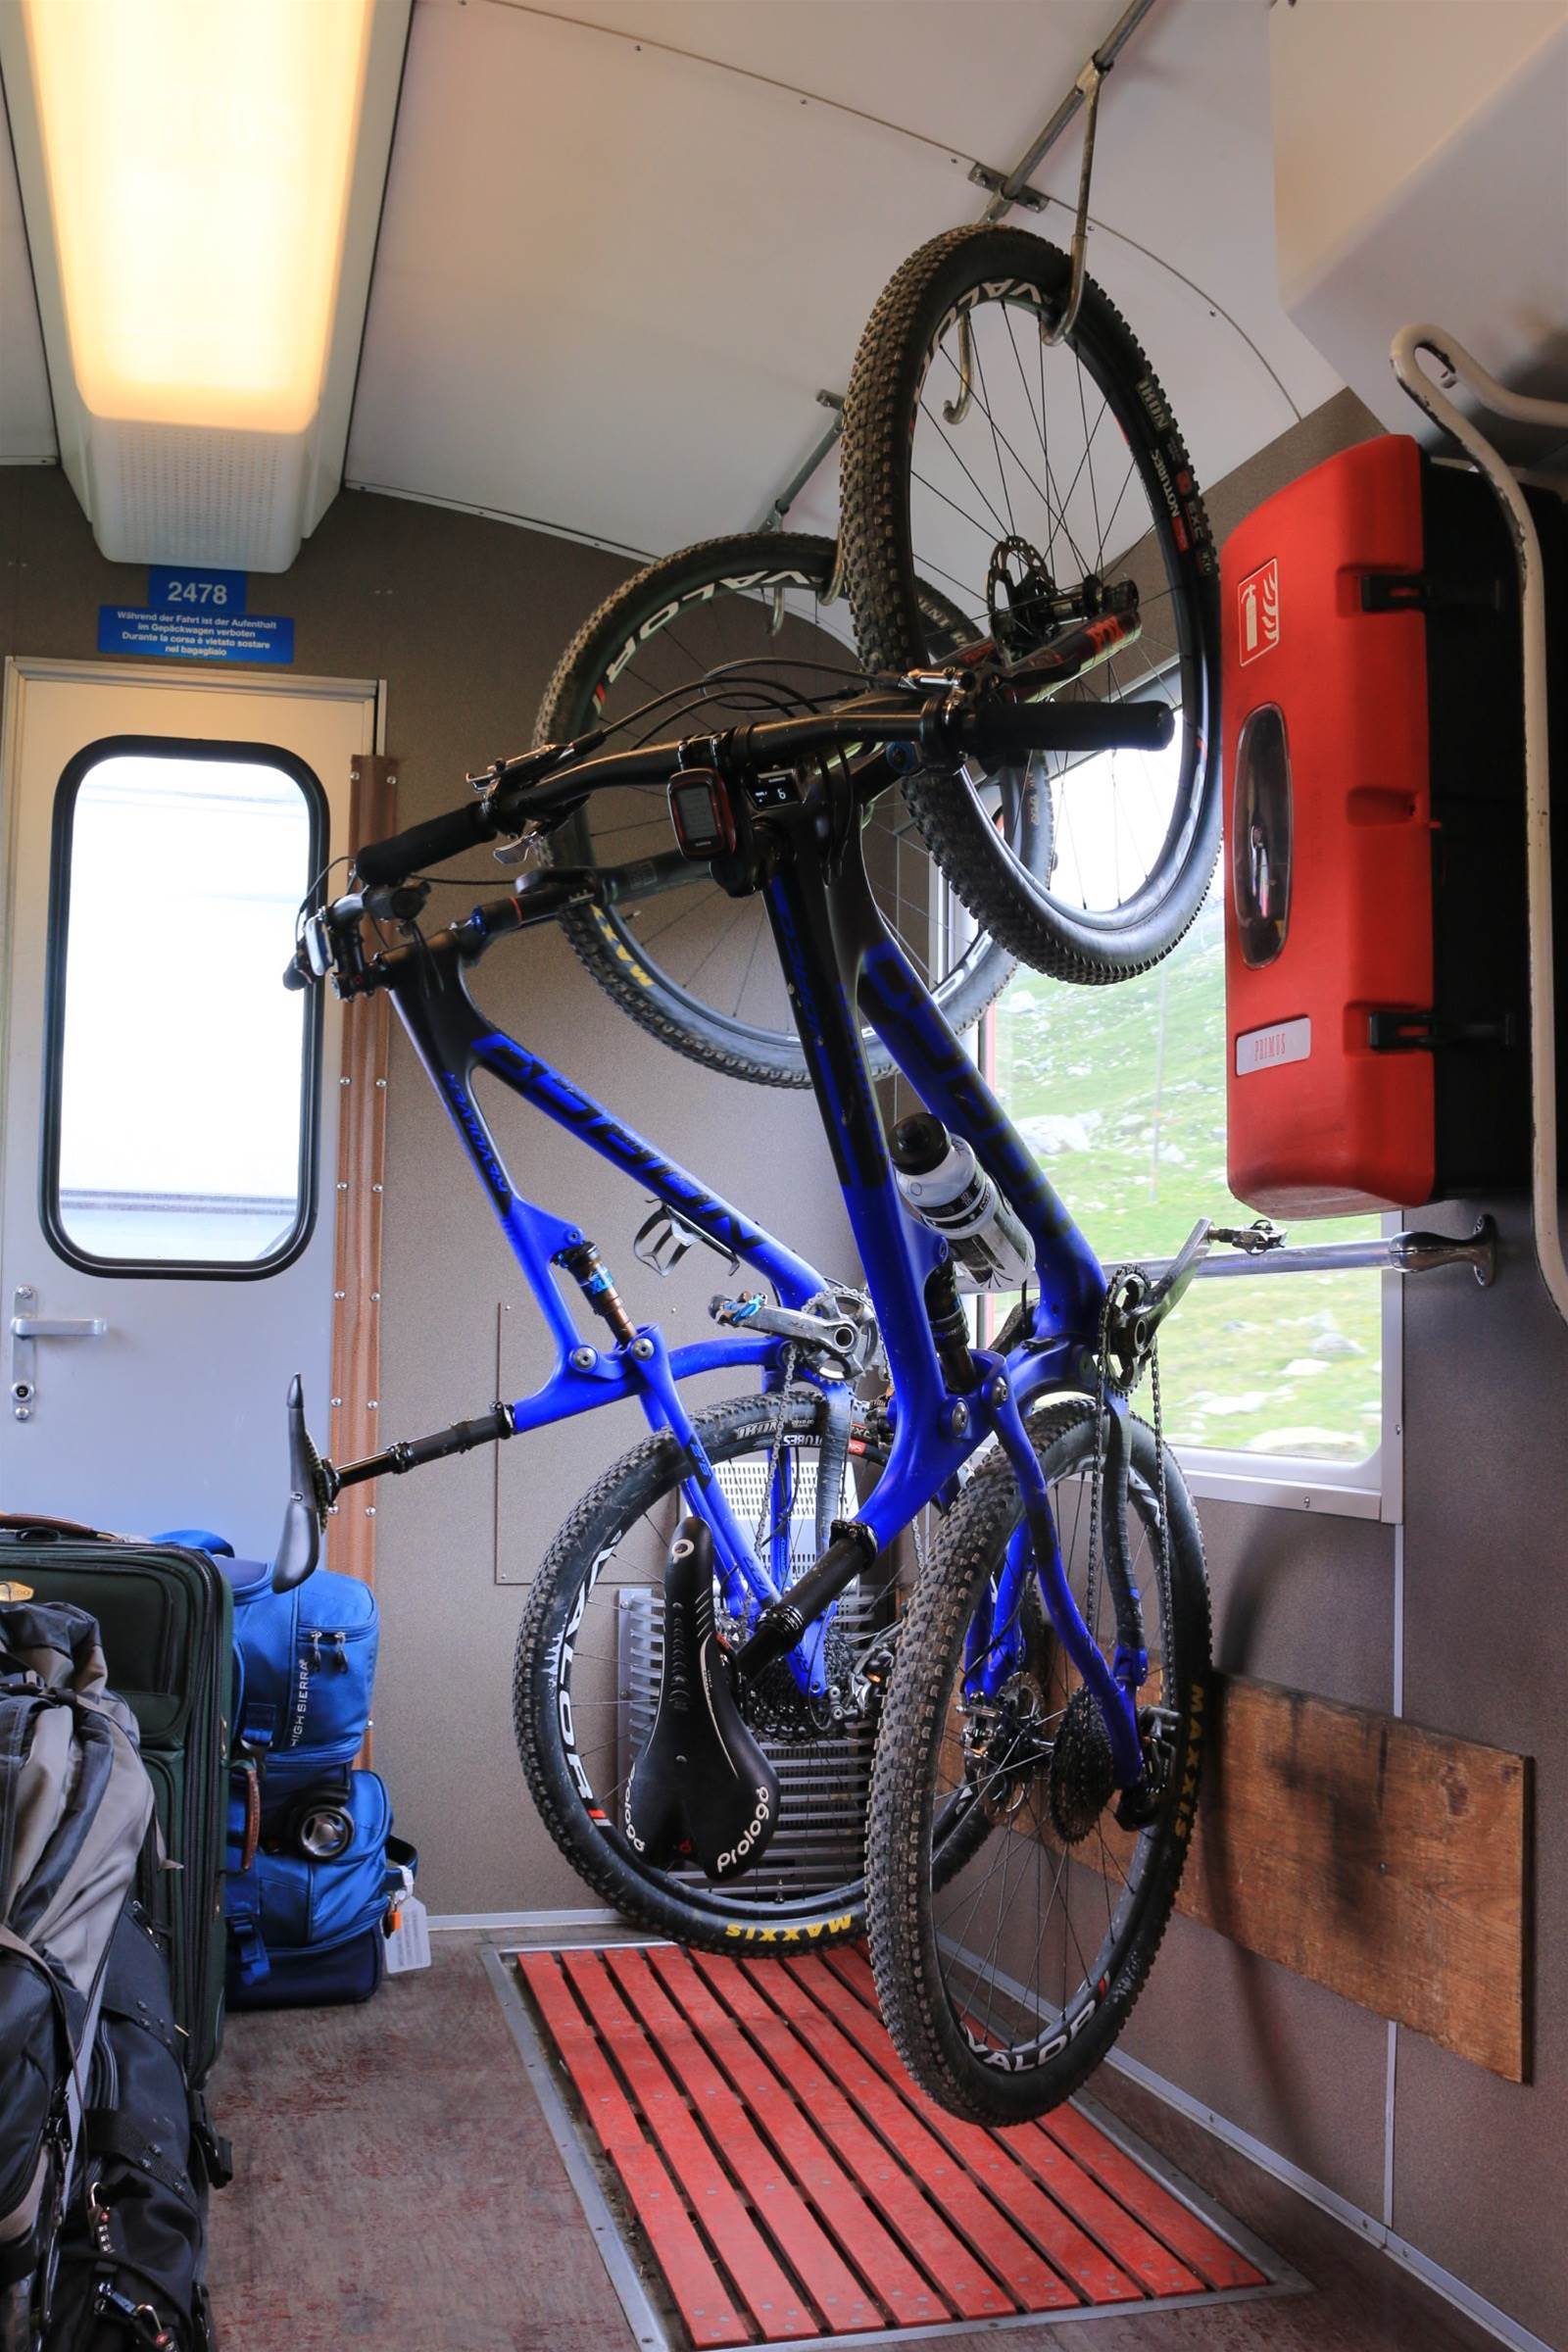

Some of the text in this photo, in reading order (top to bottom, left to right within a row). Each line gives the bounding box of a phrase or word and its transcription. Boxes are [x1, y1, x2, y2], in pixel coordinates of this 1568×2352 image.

[167, 581, 227, 605] 2478
[117, 611, 157, 621] Während
[159, 613, 173, 622] der
[176, 614, 200, 624] Fahrt
[215, 617, 229, 626] der
[231, 619, 276, 629] Aufenthalt
[122, 631, 158, 641] Durante
[237, 640, 270, 649] sostare
[138, 622, 256, 638] im Gepäckwagen verboten
[606, 570, 809, 683] VALOR
[777, 788, 786, 799] 6
[590, 904, 654, 988] MAXX
[559, 1545, 616, 1799] VALOR
[290, 1659, 309, 1747] HIGH SIERRA
[716, 1786, 771, 1873] Prologo
[725, 1913, 852, 1942] MAXXIS
[964, 1999, 1097, 2072] VALOR
